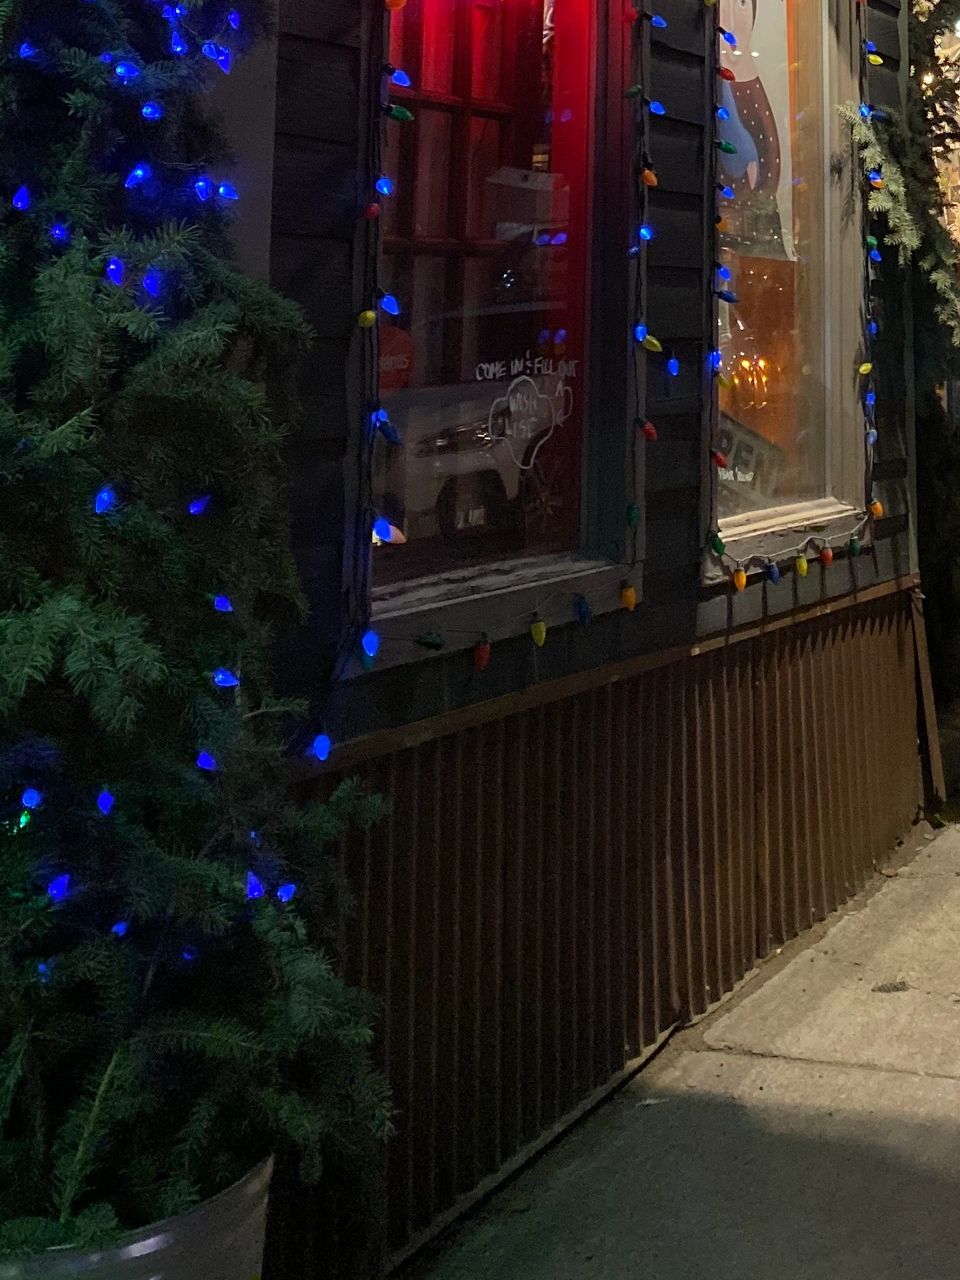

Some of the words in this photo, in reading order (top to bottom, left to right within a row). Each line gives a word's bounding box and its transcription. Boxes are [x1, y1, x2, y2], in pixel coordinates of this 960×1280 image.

[476, 360, 507, 381] COME
[510, 357, 524, 375] IN
[533, 356, 556, 376] FILL
[557, 360, 580, 377] OUT
